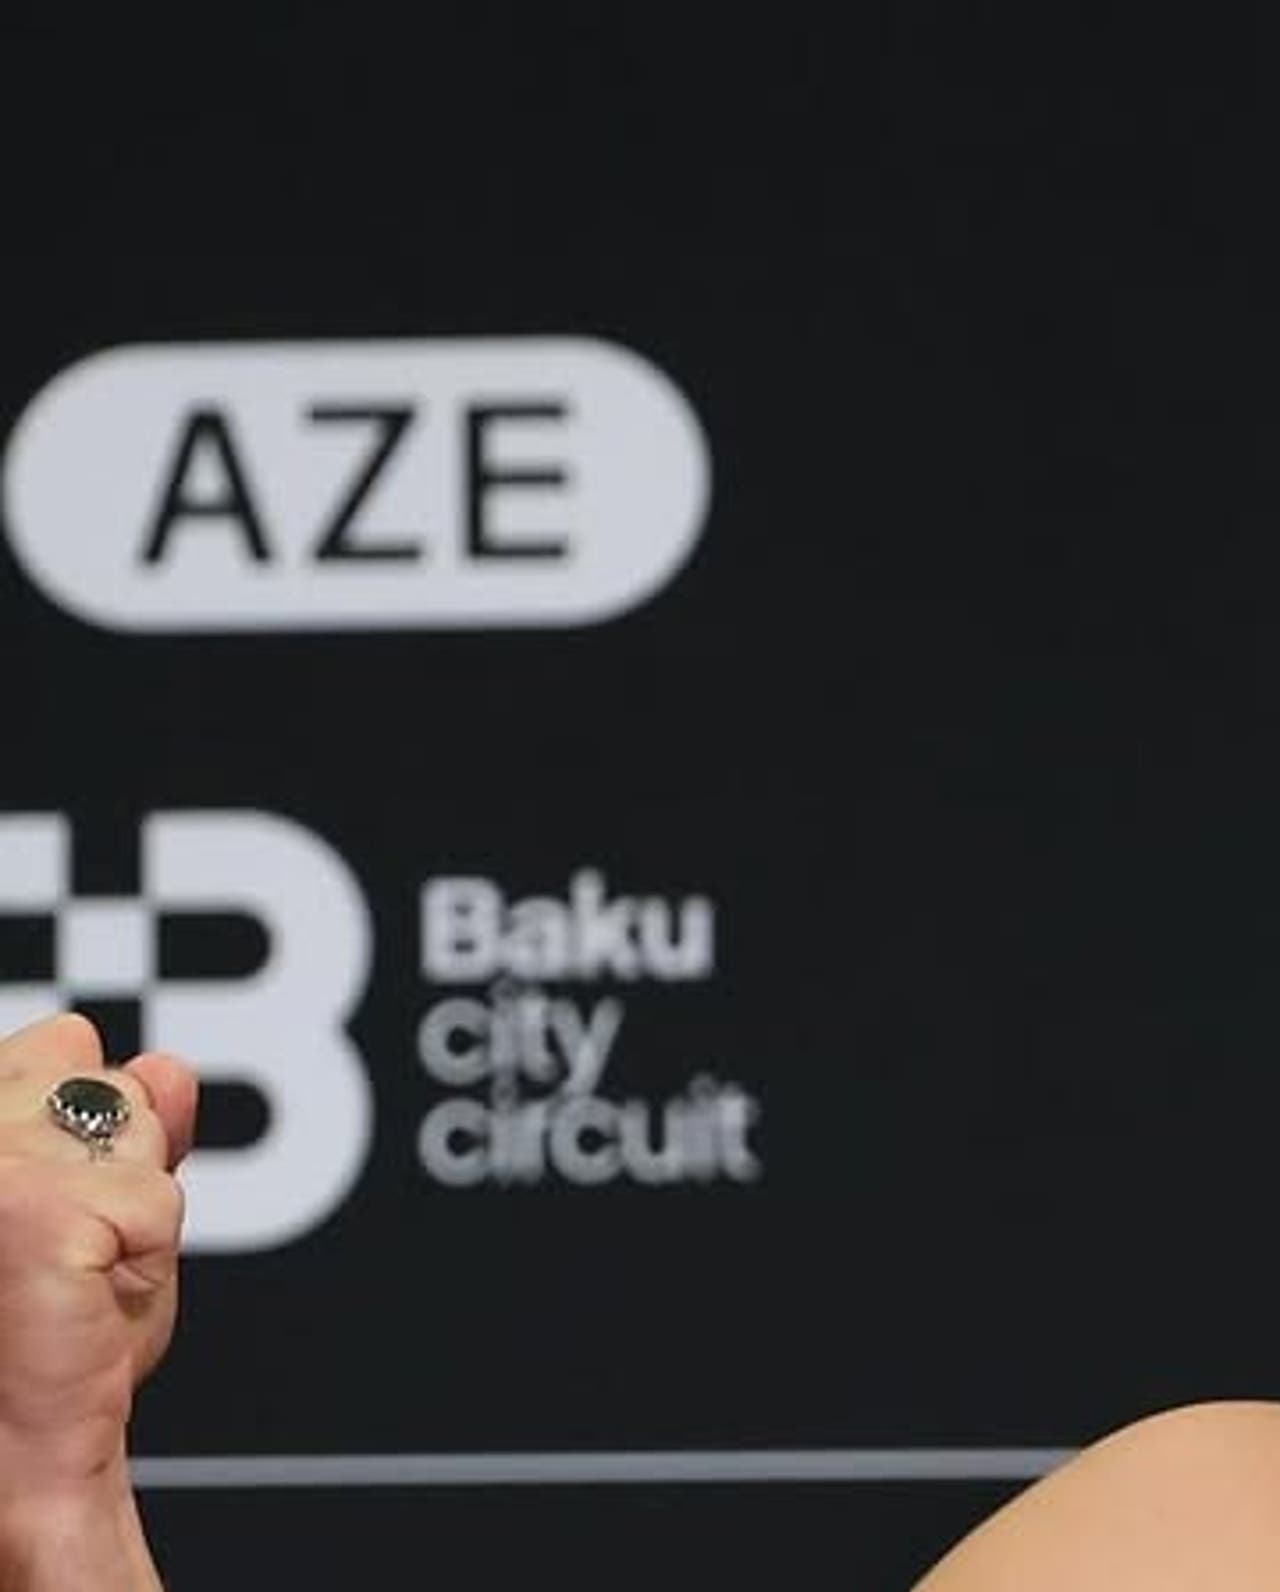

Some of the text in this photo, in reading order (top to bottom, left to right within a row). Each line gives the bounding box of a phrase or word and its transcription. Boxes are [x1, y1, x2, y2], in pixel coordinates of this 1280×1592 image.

[140, 399, 570, 567] AZE
[420, 866, 714, 983] Baku
[417, 978, 625, 1097] city
[417, 1075, 762, 1187] circuit
